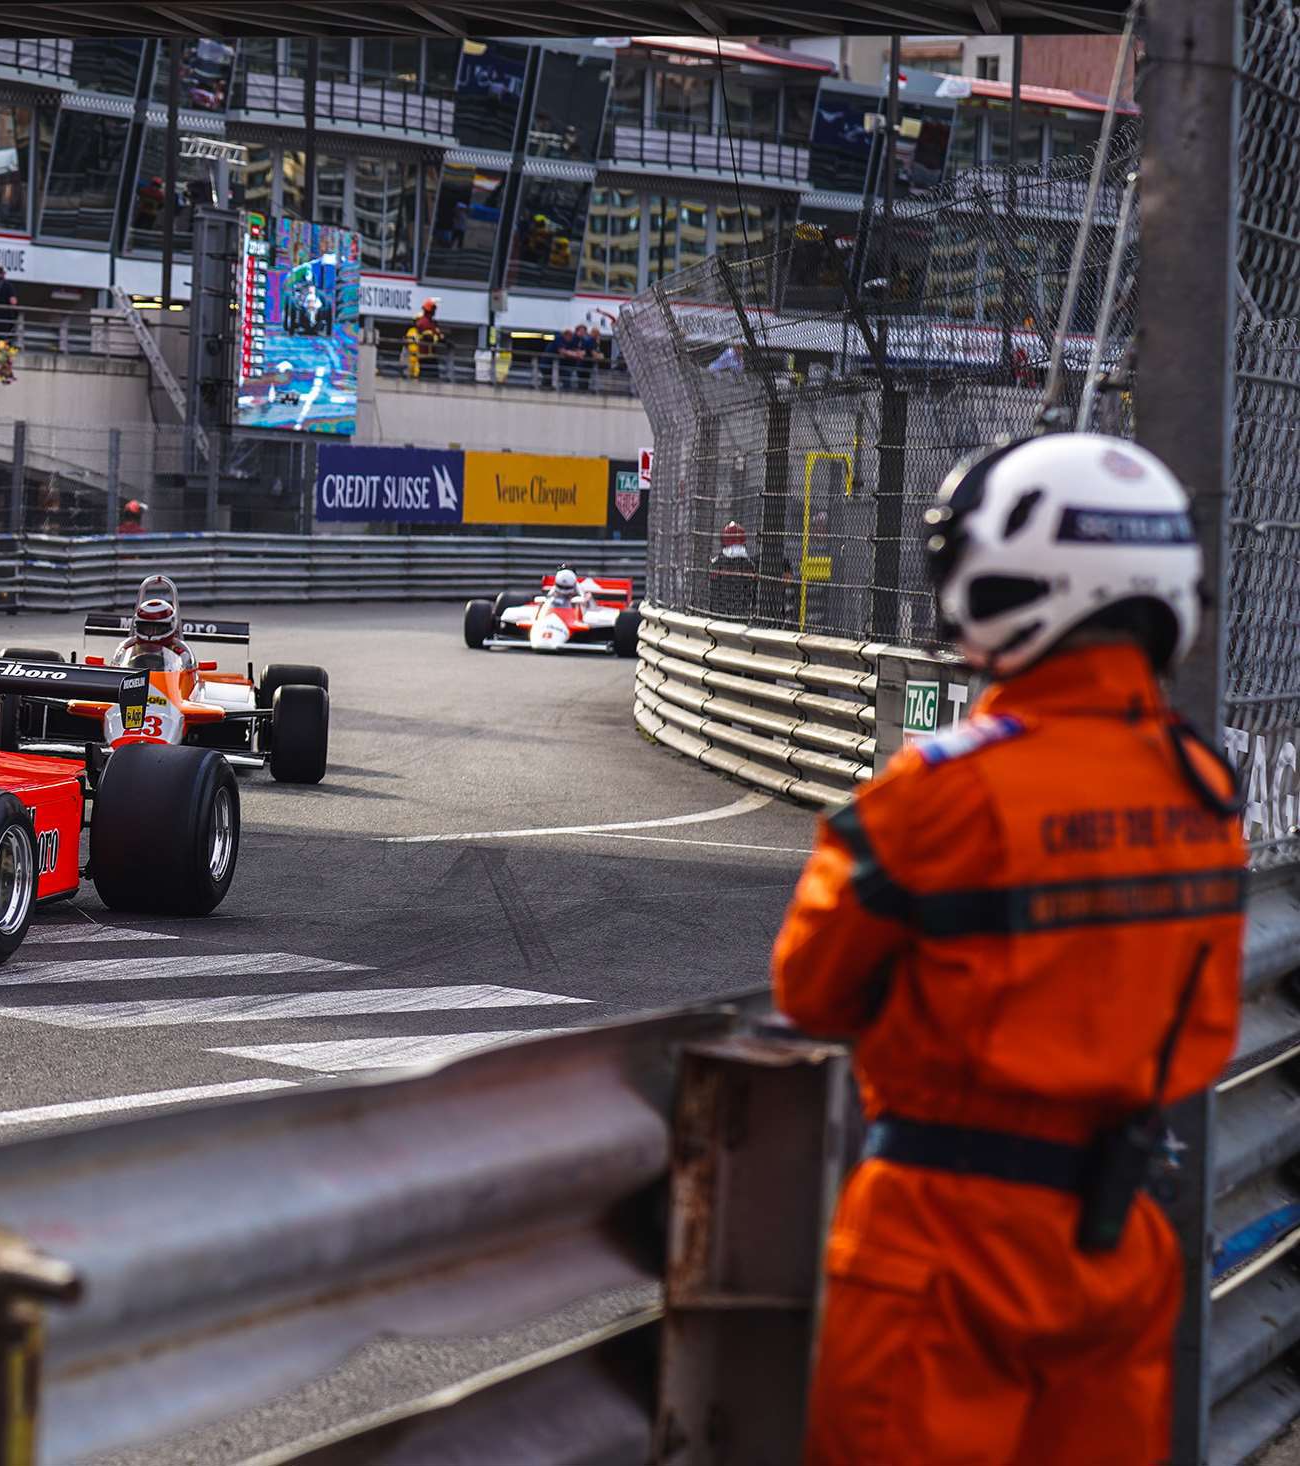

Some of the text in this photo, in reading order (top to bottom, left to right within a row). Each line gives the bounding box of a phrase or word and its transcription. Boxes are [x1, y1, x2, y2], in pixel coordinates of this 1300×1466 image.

[323, 474, 430, 509] CREDIT SUISSE
[495, 473, 576, 512] Veuve Clicquot
[120, 617, 217, 633] Moro
[908, 689, 936, 728] TAG
